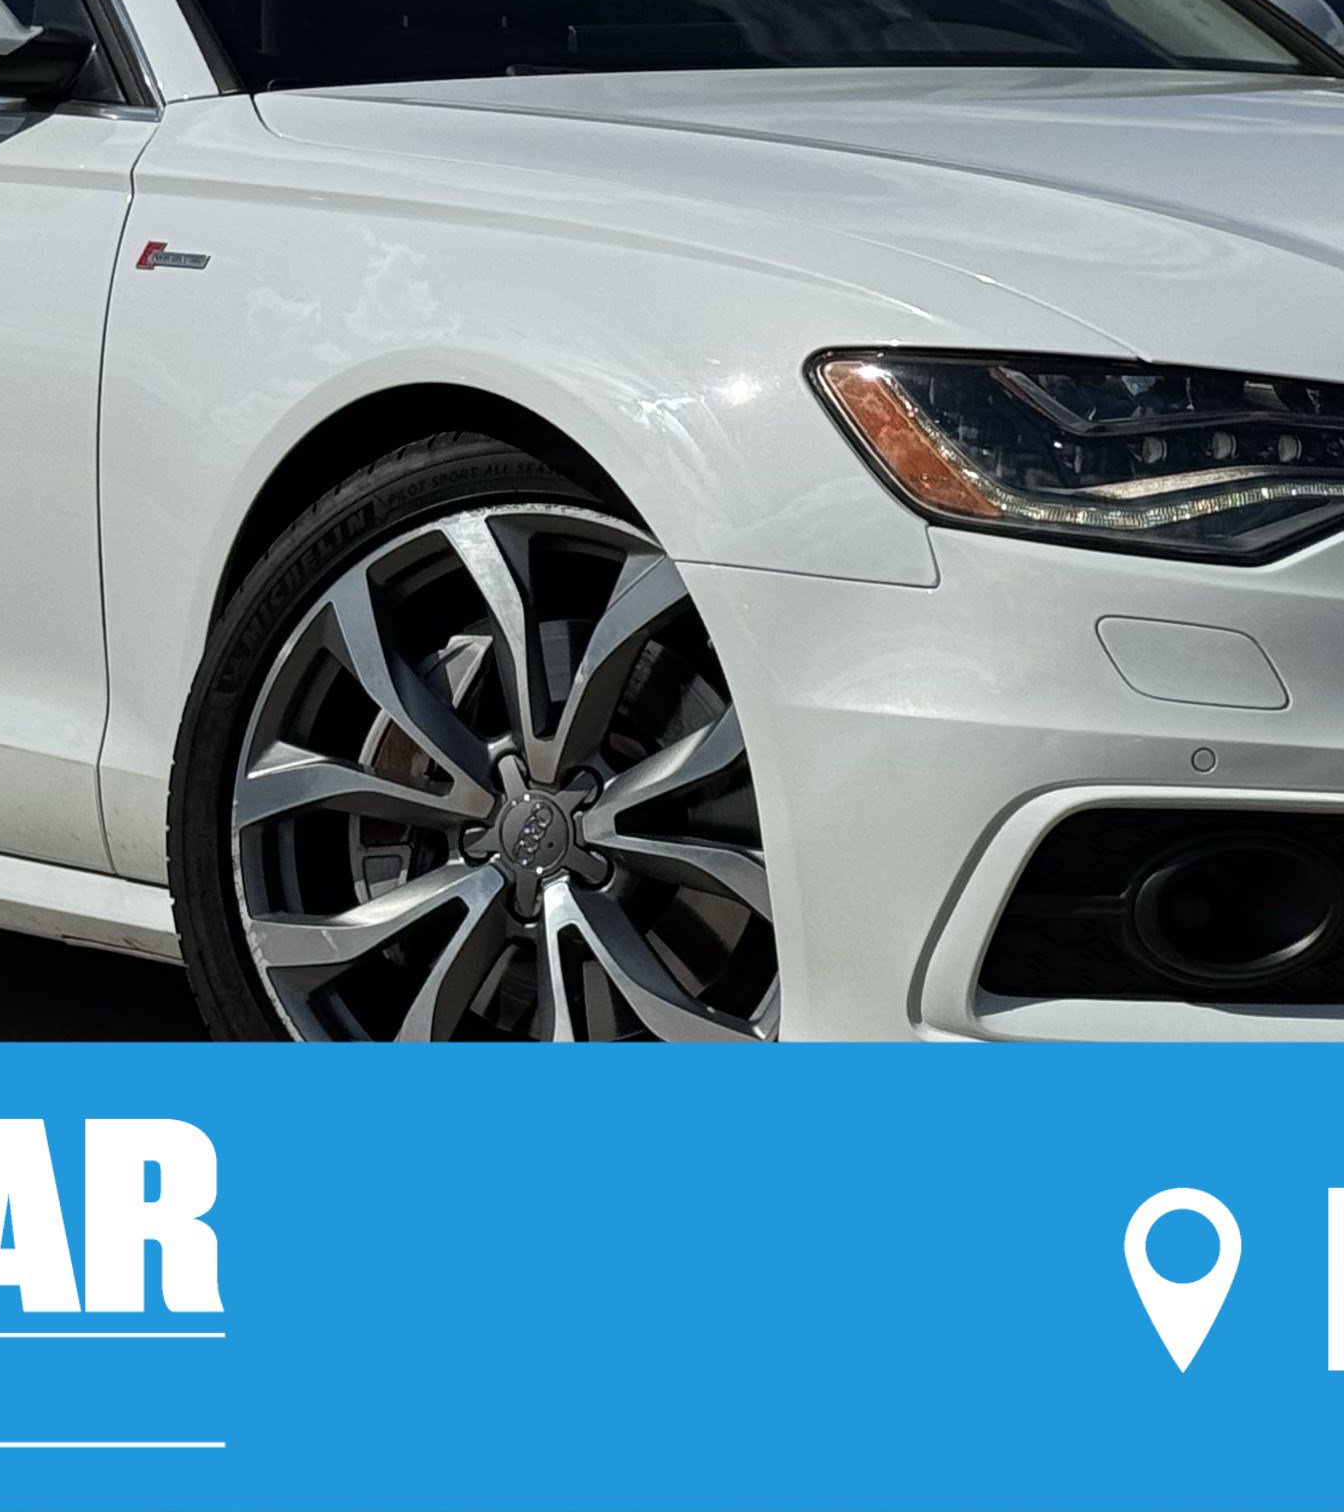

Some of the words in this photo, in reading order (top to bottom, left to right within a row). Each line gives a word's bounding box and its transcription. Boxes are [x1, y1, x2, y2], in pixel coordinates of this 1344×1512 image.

[388, 480, 426, 504] PILOT
[432, 466, 478, 487] SPORT
[484, 464, 509, 475] ALL
[241, 508, 366, 649] MICHELIN
